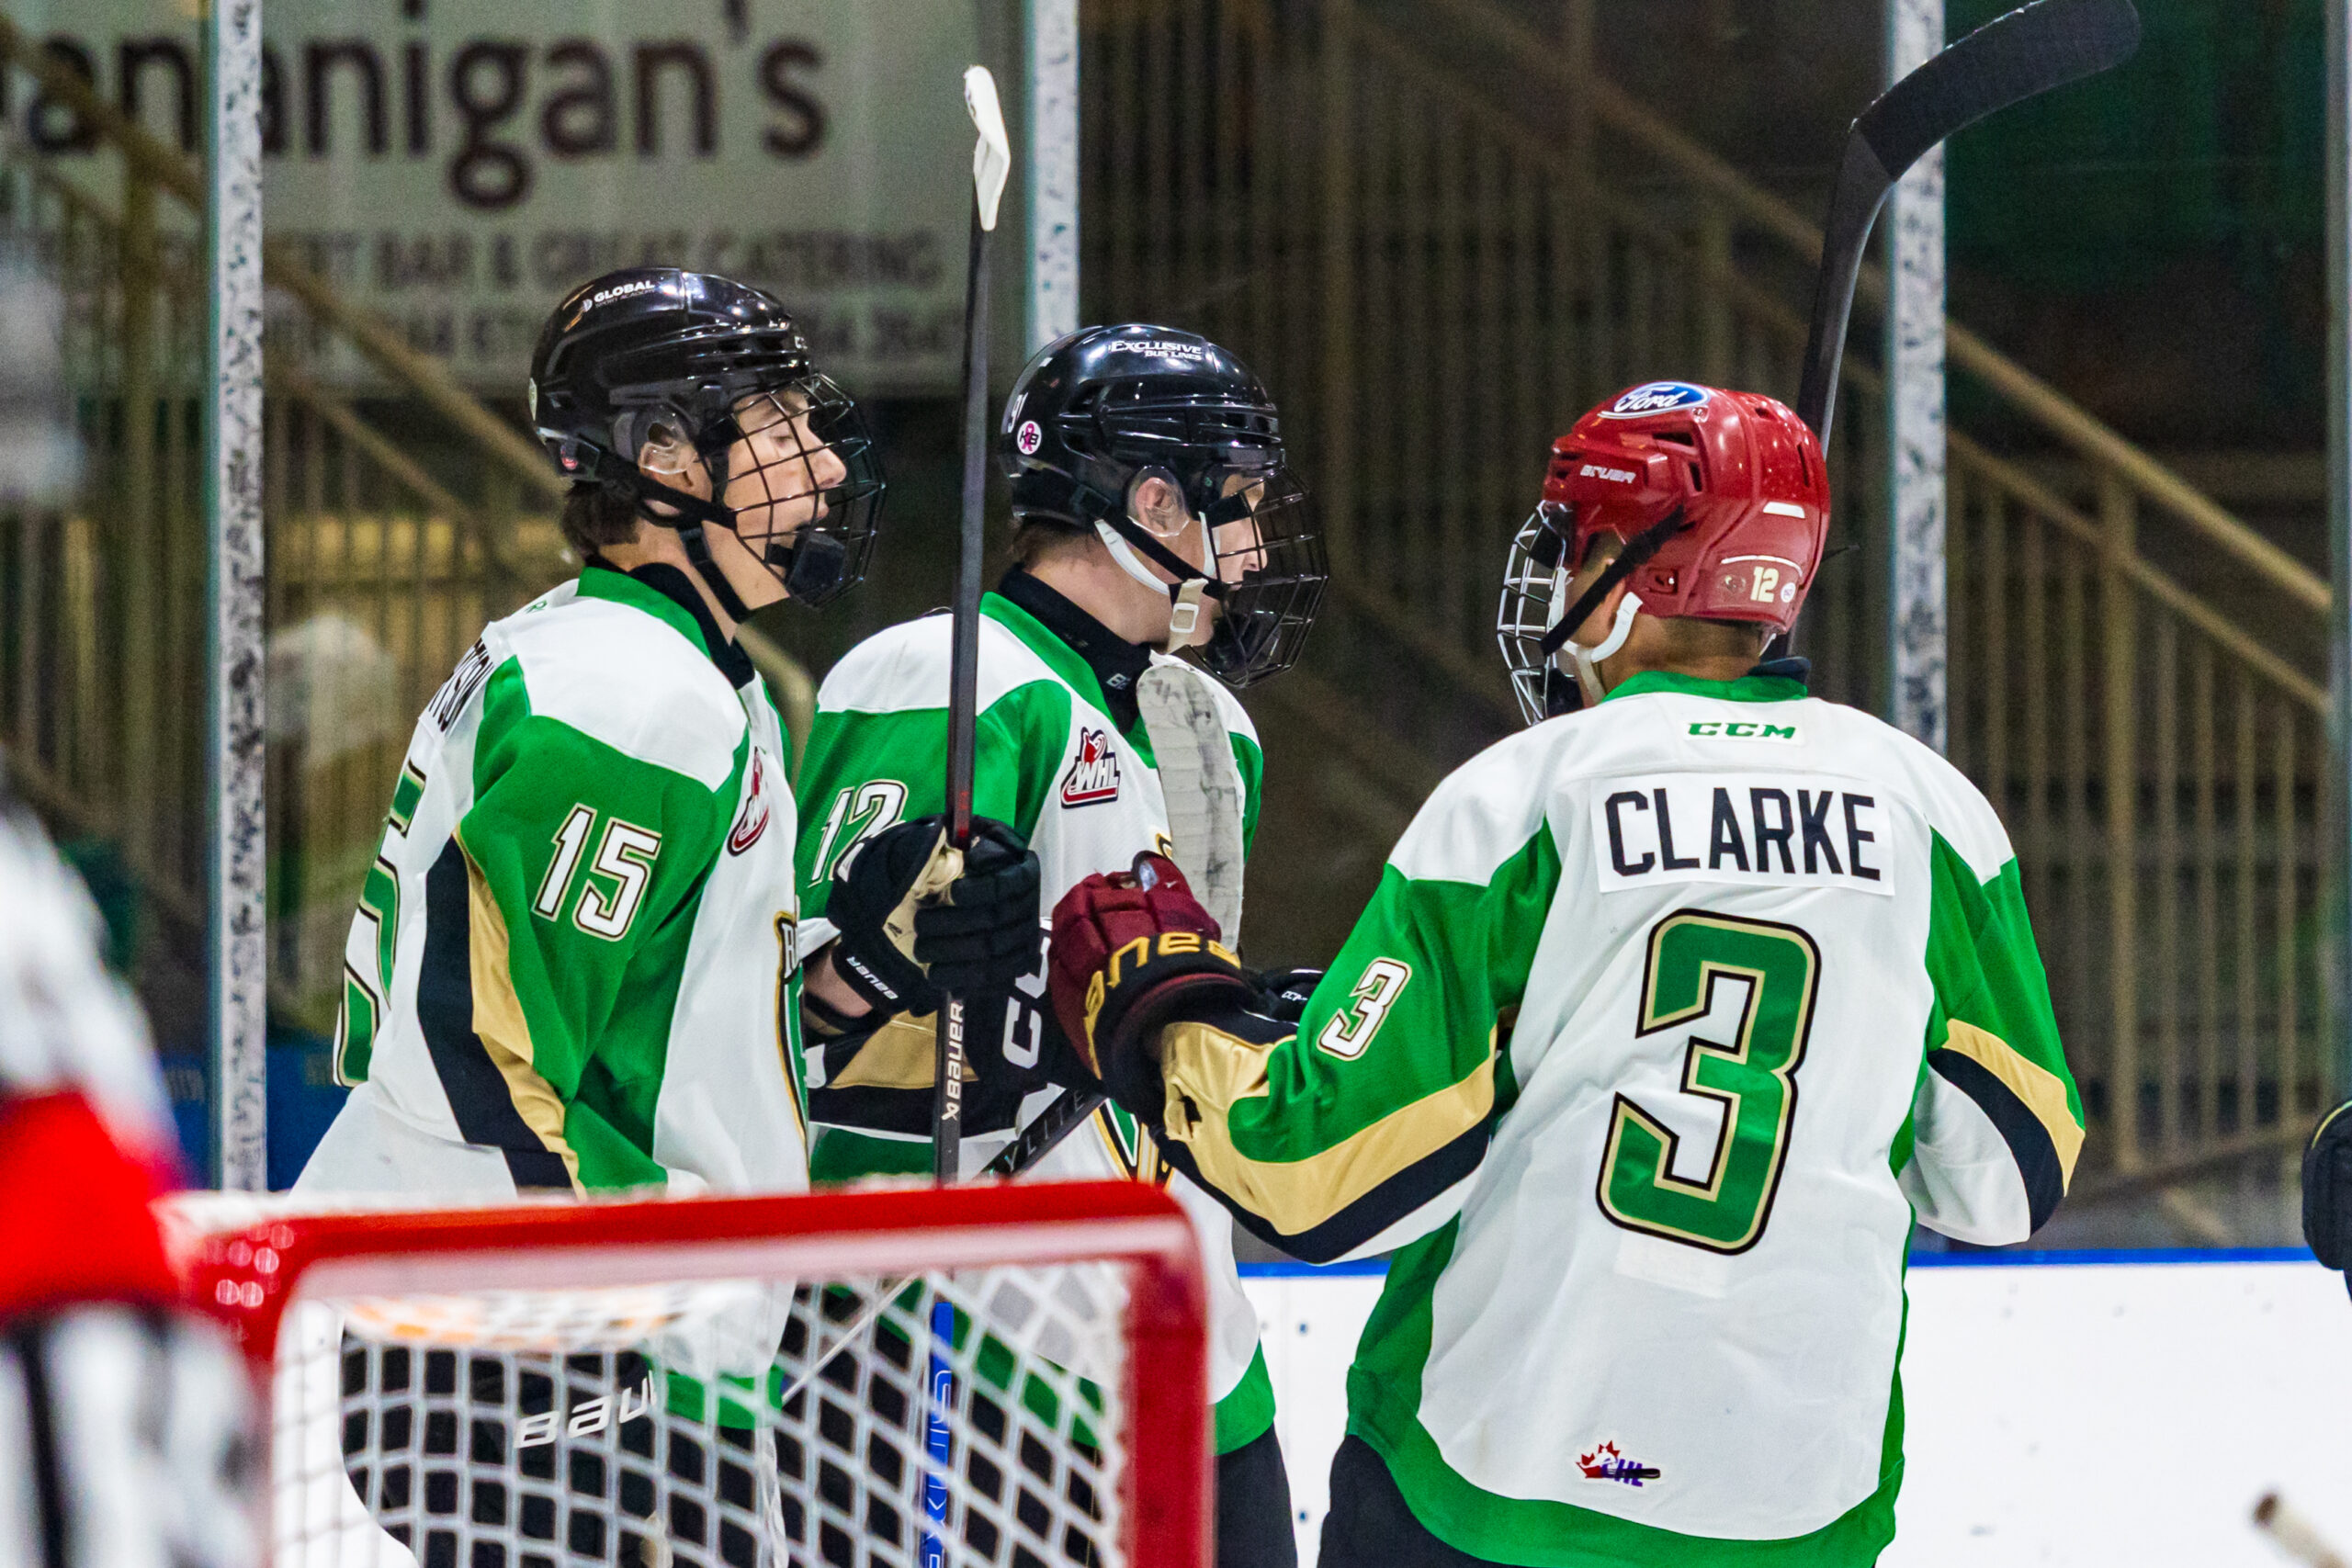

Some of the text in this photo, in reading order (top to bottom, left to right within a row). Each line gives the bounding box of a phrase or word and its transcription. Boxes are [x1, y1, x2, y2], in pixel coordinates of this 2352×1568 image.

[594, 280, 655, 302] GLOBAL
[1110, 340, 1203, 355] EXCLUSIVE
[1613, 386, 1689, 413] Ford
[1750, 566, 1780, 603] 12
[1688, 721, 1797, 739] CCM
[1074, 756, 1119, 792] WHL
[807, 778, 909, 888] 12
[1604, 786, 1882, 882] CLARKE
[530, 802, 662, 942] 15
[1316, 956, 1412, 1062] 3
[1595, 908, 1822, 1256] 3
